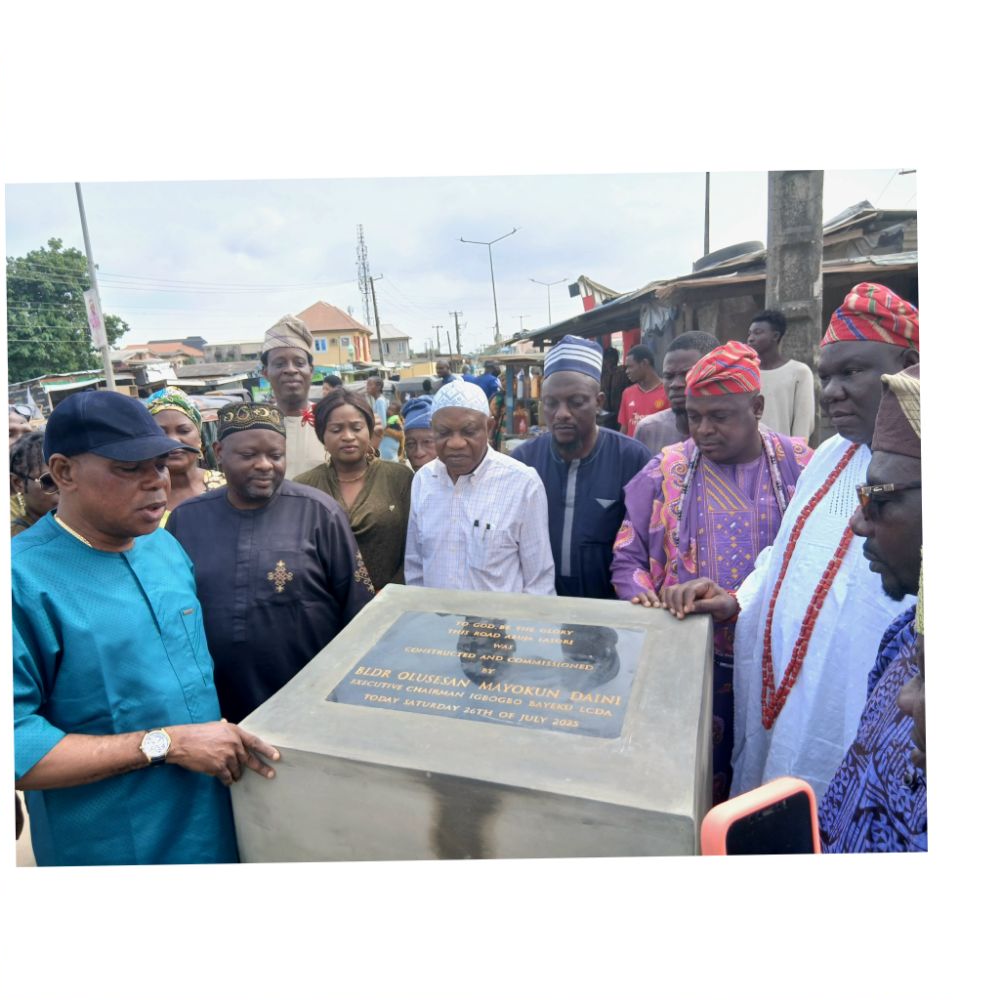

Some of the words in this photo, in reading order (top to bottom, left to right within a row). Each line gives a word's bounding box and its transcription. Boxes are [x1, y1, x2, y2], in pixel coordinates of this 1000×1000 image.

[448, 628, 469, 636] THIS
[474, 631, 501, 639] ROAD
[540, 627, 575, 636] GLORY
[492, 642, 514, 650] WAS
[404, 646, 476, 659] CONSTRUCTED
[480, 654, 504, 662] AND
[507, 656, 595, 672] COMMISSIONED
[480, 667, 496, 675] BY
[354, 666, 392, 679] BLDR
[397, 671, 471, 688] OLUSESAN
[478, 681, 560, 698] MAYOKUN
[570, 691, 621, 705] DAINI
[350, 679, 403, 691] EXECUTIVE
[406, 685, 465, 698] CHAIRMAN
[528, 700, 574, 712] BAYEKU
[579, 706, 613, 717] LCDA
[363, 693, 400, 704] TODAY
[403, 698, 461, 712] SATURDAY
[463, 706, 494, 717] 26TH
[498, 711, 515, 719] OF
[519, 714, 546, 724] JULY
[552, 718, 579, 728] 2025
